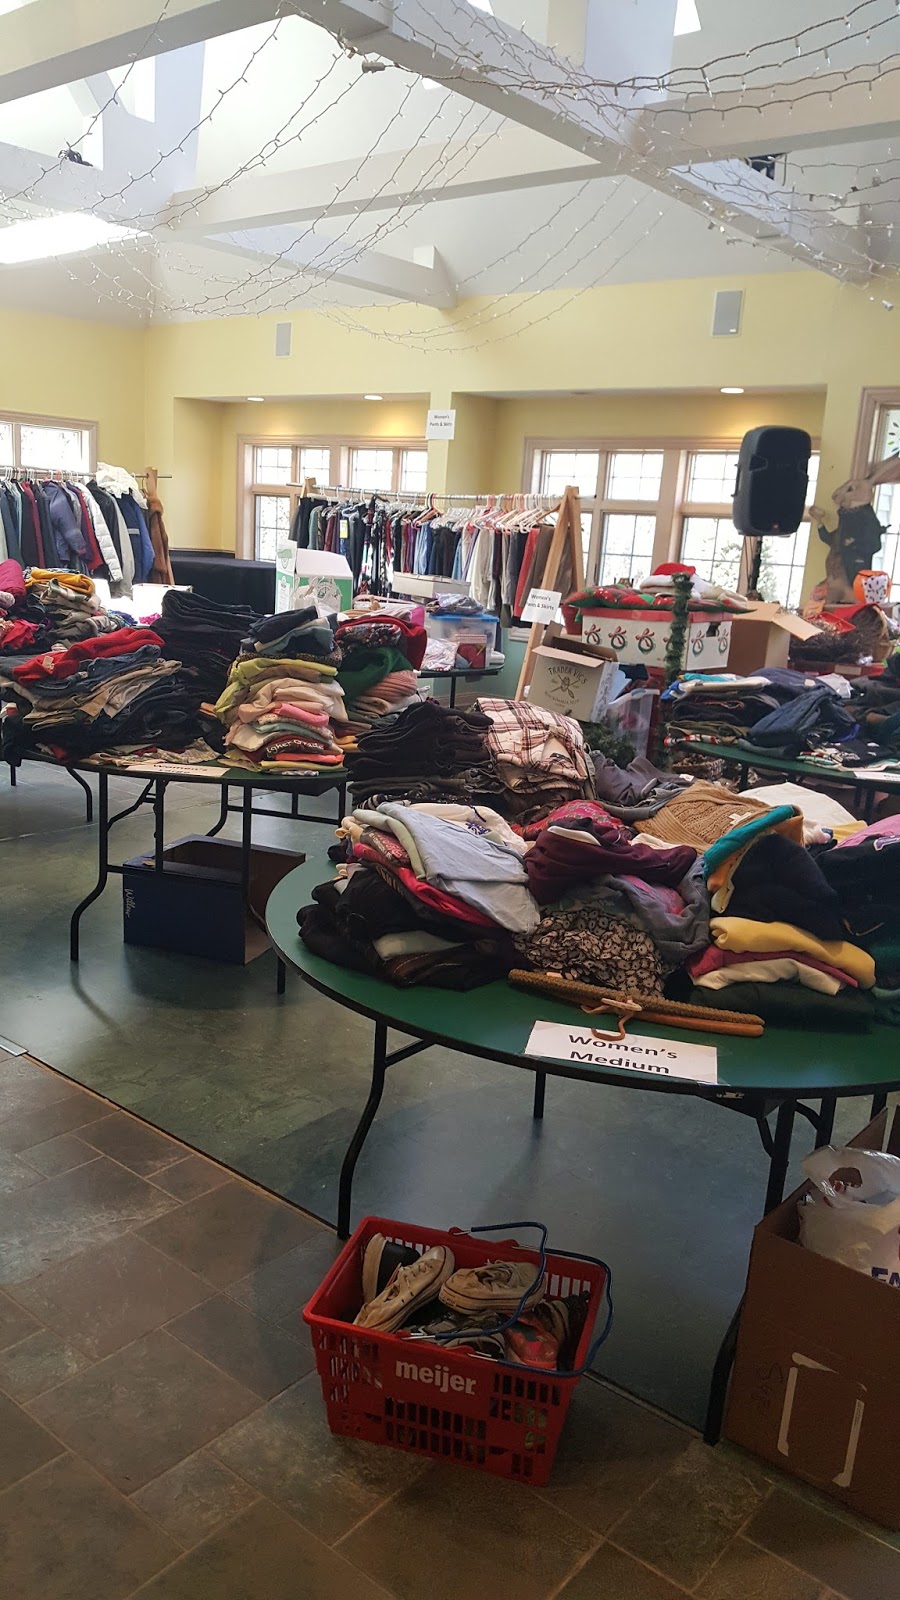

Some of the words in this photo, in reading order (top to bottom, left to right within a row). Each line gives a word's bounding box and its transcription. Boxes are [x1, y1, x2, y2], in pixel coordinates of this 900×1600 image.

[531, 594, 551, 602] Women's
[541, 603, 554, 611] Skirts
[548, 666, 573, 676] TRADER
[266, 740, 292, 754] igher
[568, 1033, 678, 1059] Women's
[569, 1050, 670, 1074] Medium
[395, 1360, 477, 1395] meijer
